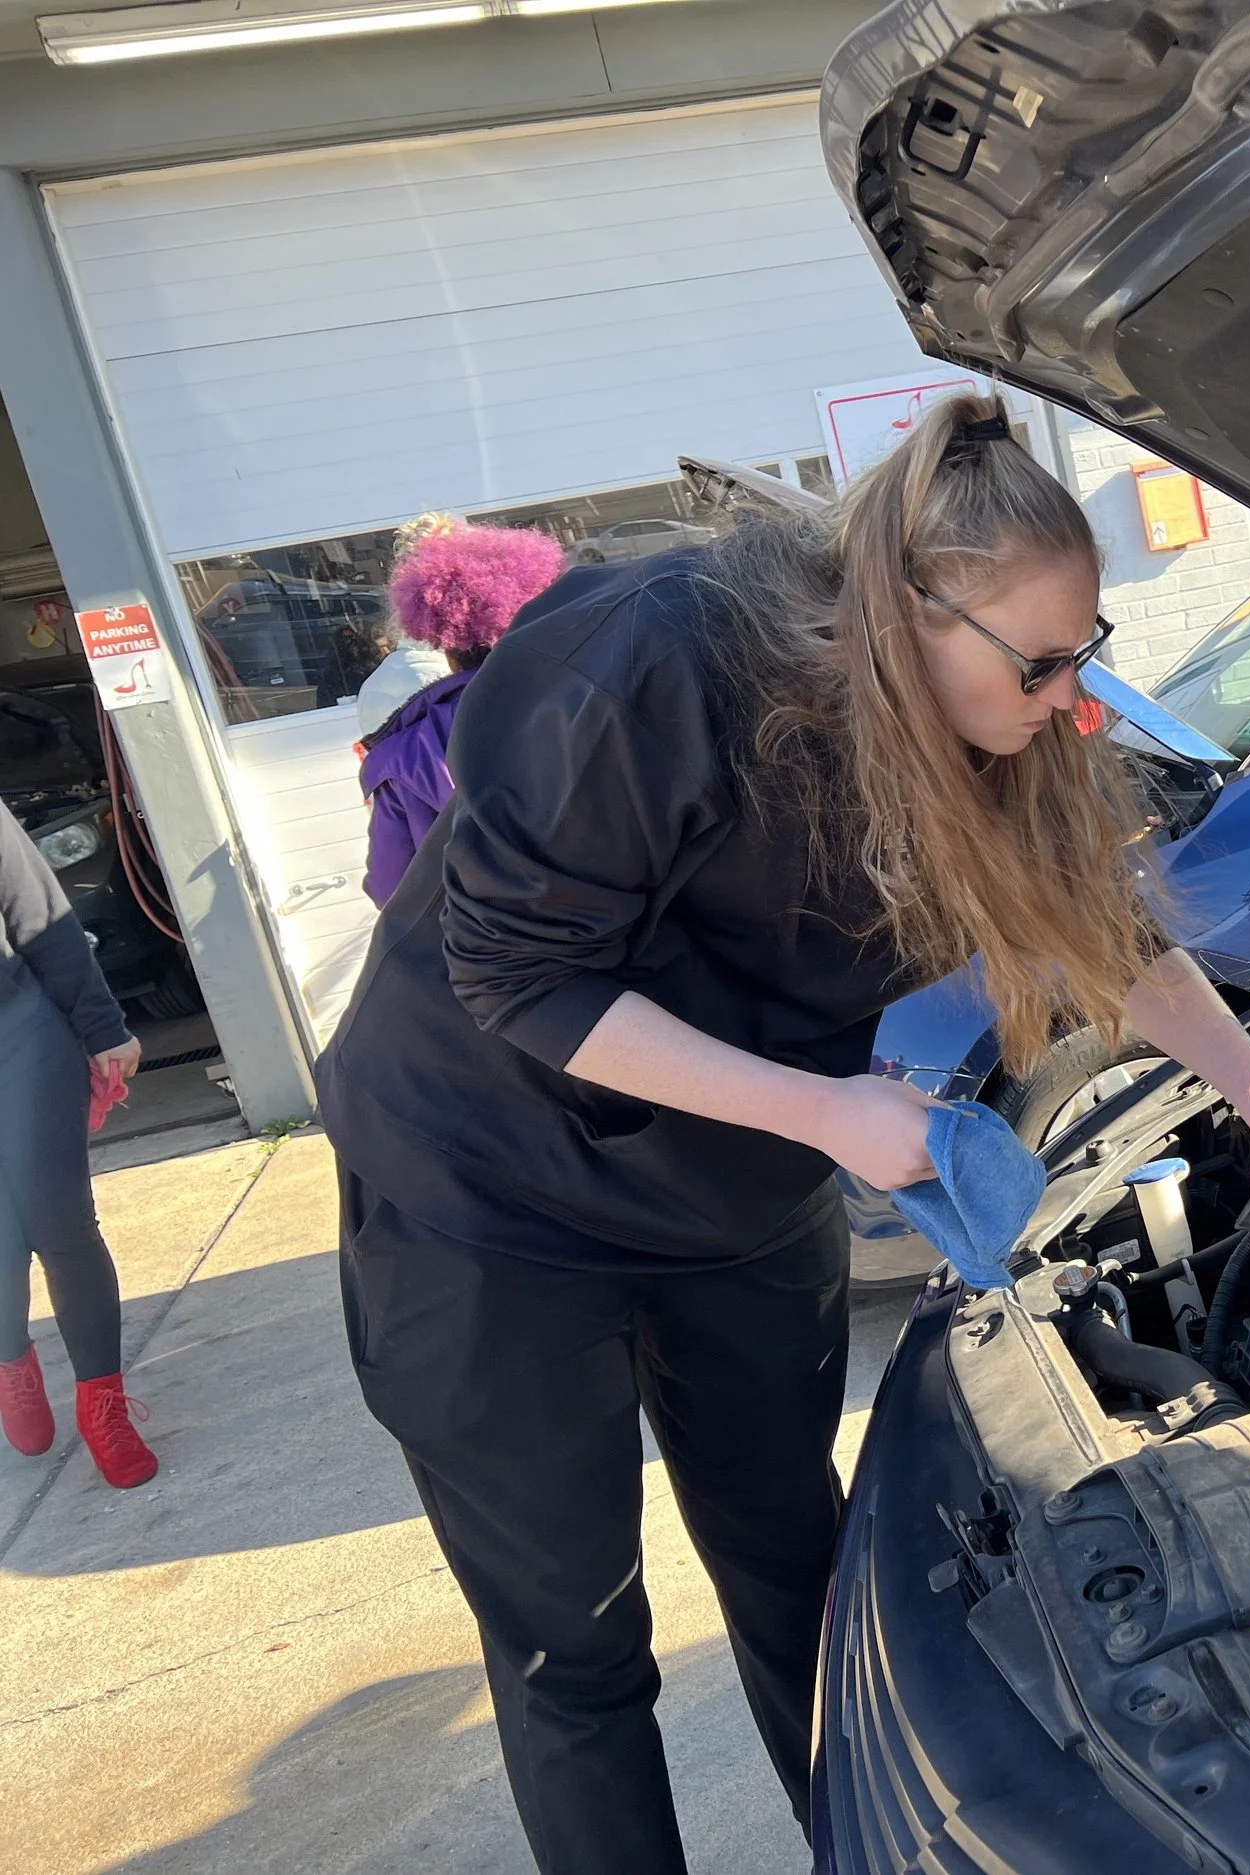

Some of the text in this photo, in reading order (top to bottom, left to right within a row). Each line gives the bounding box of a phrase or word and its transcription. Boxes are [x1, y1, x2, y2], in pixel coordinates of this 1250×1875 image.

[105, 610, 126, 622] NO
[90, 624, 149, 641] PARKING
[92, 638, 156, 657] ANYTIME
